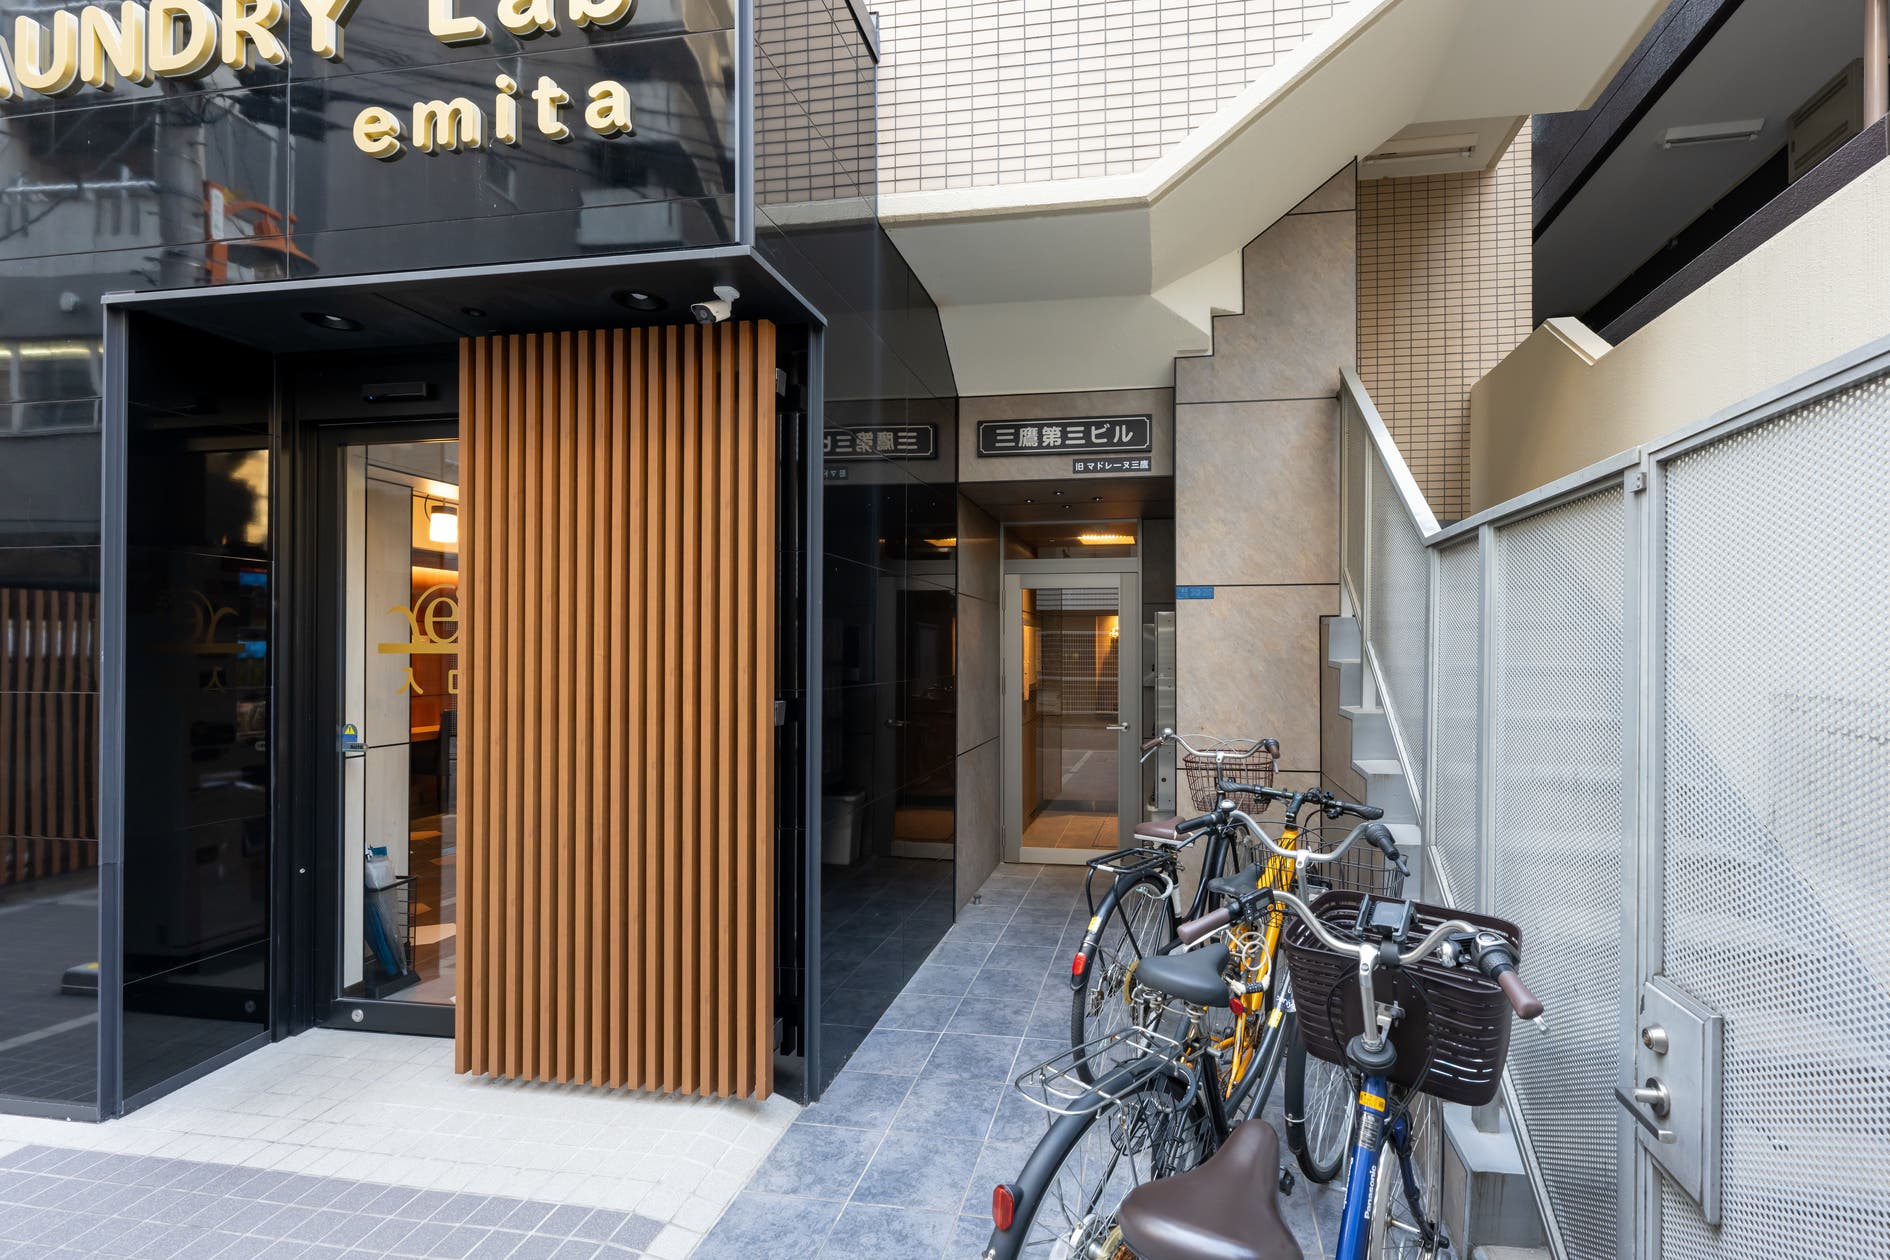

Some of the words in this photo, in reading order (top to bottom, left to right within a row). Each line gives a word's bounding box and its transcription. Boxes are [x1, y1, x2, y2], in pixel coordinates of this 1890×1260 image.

[353, 73, 633, 158] emita
[995, 423, 1134, 448] 三鷹第三ビル
[1364, 1165, 1377, 1219] Panasonic
